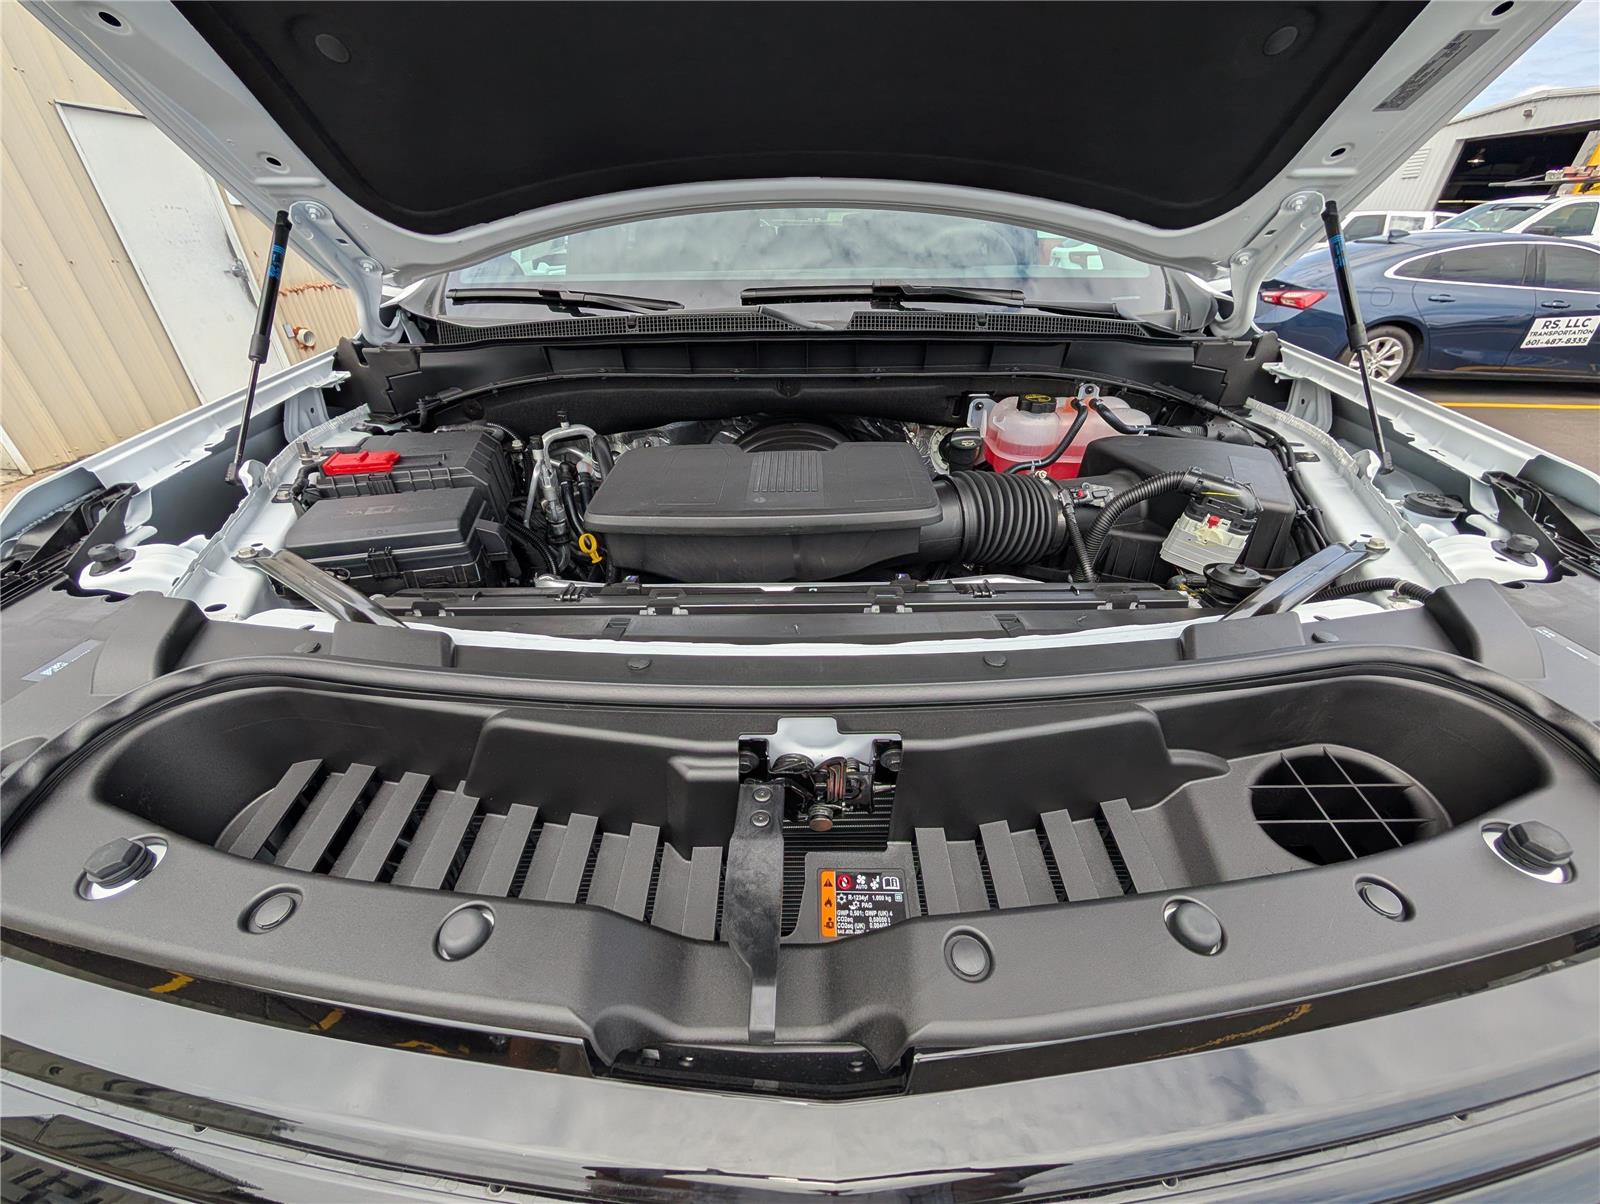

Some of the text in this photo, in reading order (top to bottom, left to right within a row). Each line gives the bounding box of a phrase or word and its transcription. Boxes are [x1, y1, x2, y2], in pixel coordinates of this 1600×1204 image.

[1565, 318, 1592, 328] LLC
[1529, 329, 1595, 337] TRANSPORTATION
[1525, 337, 1589, 346] 601-487-8335
